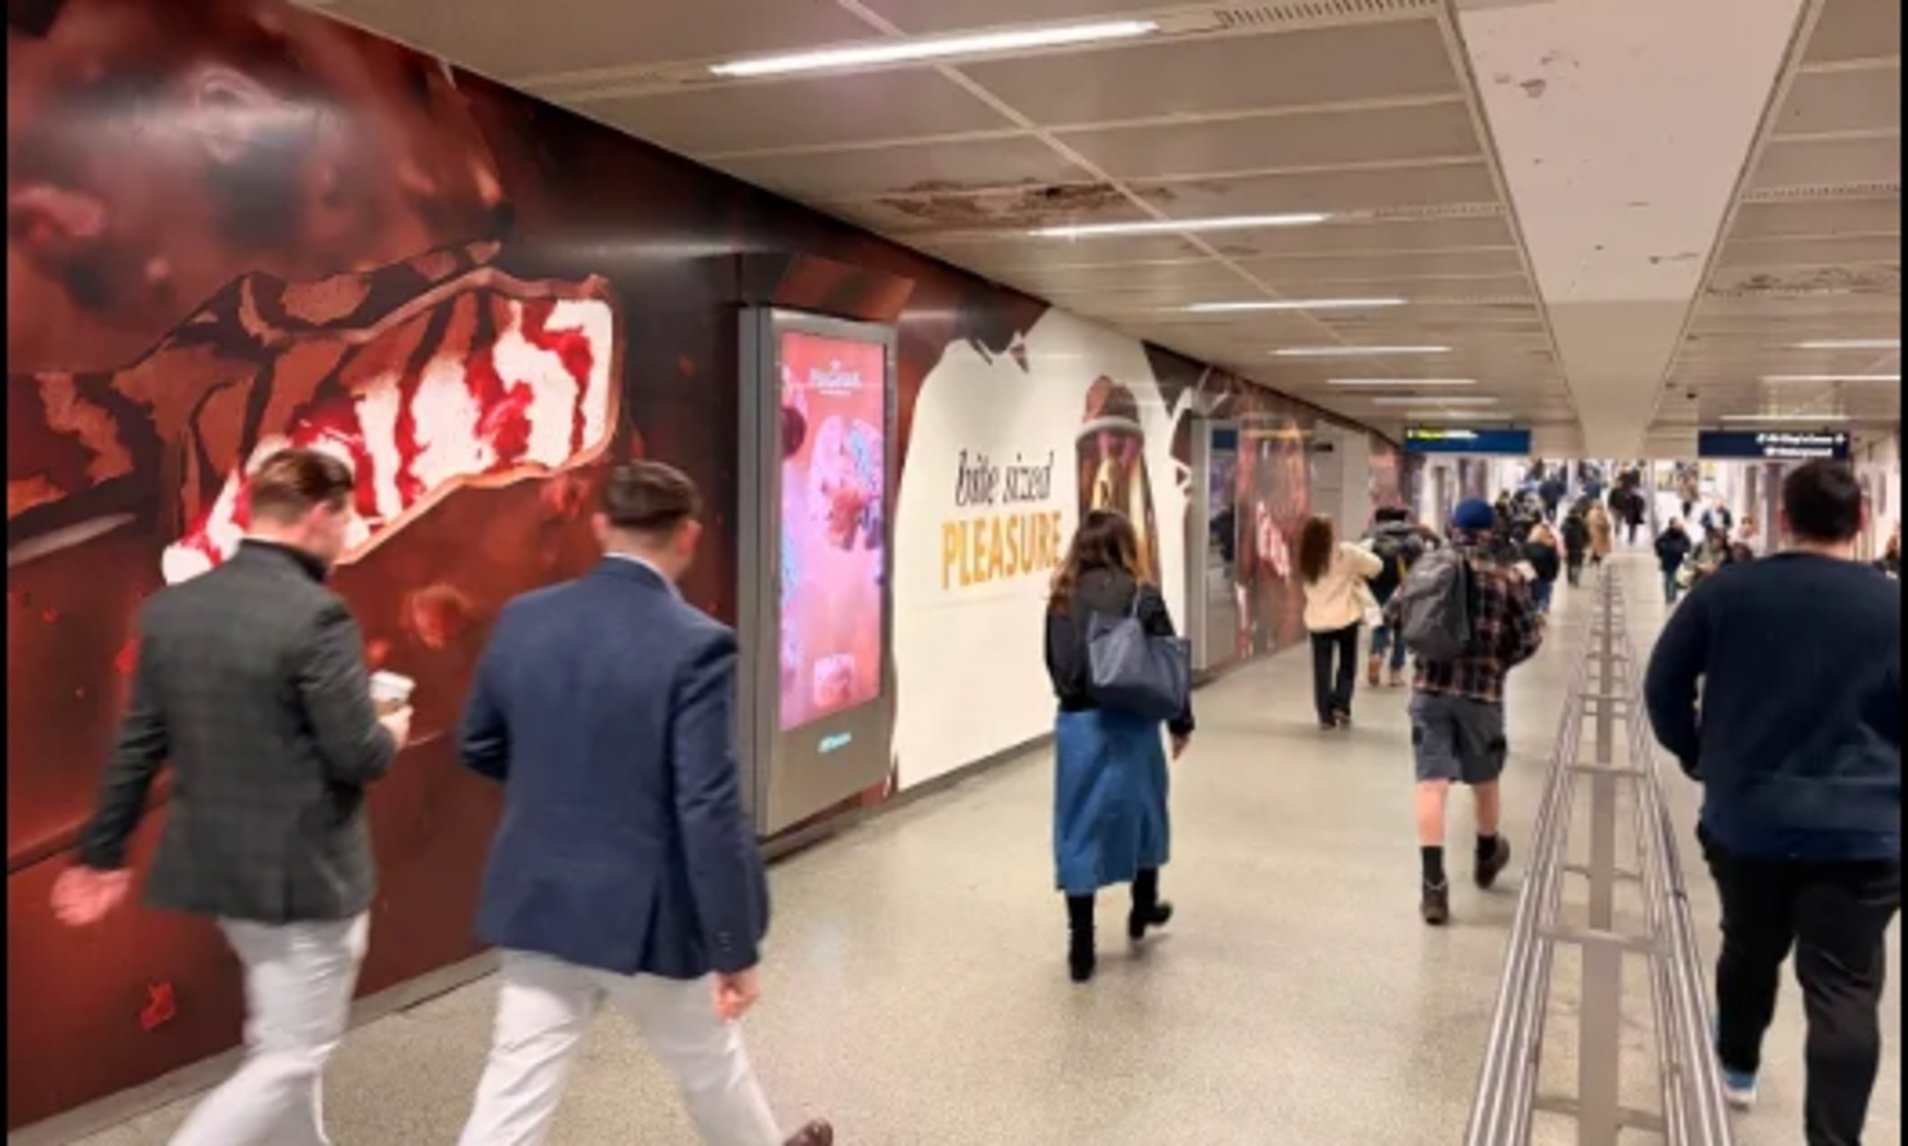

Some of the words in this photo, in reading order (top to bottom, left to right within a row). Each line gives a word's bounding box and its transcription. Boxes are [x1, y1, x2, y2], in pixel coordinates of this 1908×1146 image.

[955, 448, 999, 507] bite
[1003, 449, 1054, 503] sized
[941, 511, 1062, 591] PLEASURE
